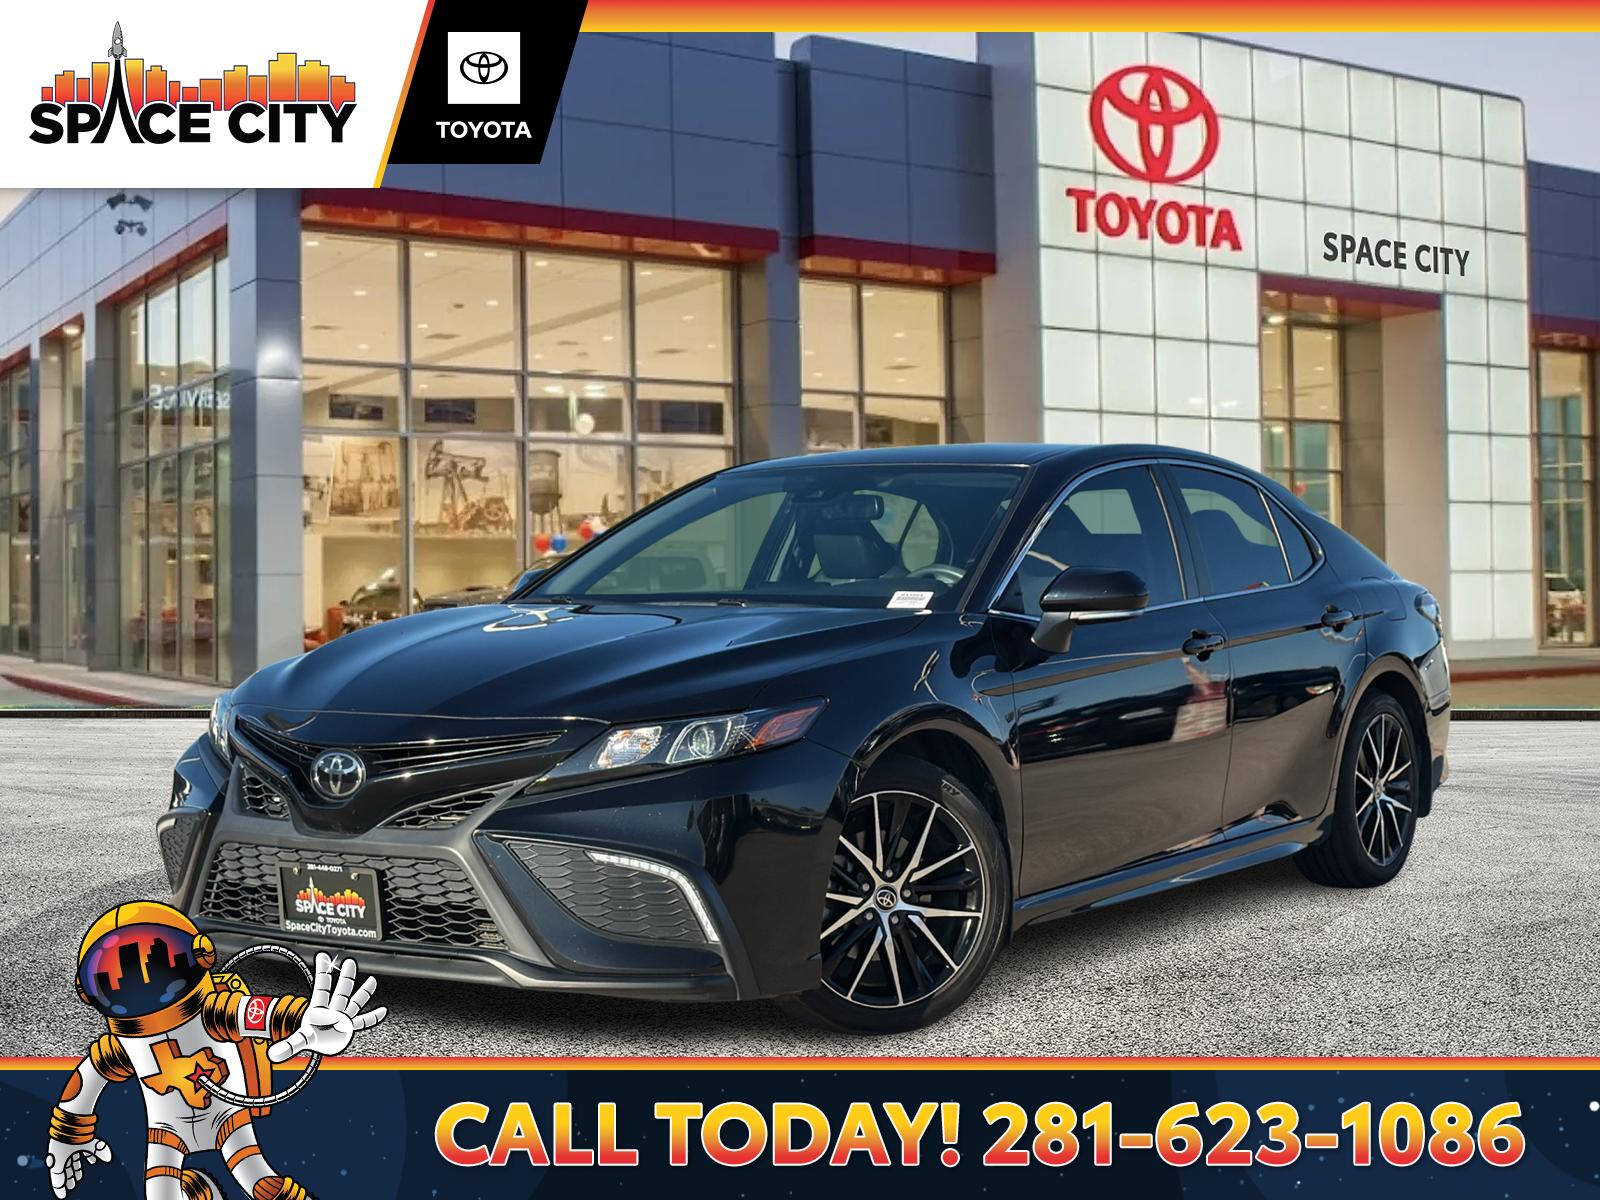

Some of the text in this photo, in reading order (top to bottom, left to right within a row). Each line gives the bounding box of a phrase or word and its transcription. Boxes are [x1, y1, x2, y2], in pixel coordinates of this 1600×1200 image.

[1067, 188, 1242, 251] TOYOTA
[1323, 232, 1470, 277] SPACE CITY
[295, 894, 366, 919] SPACE CITY
[285, 920, 377, 938] SpaceCityToyota.com
[326, 917, 347, 925] TOYOTA
